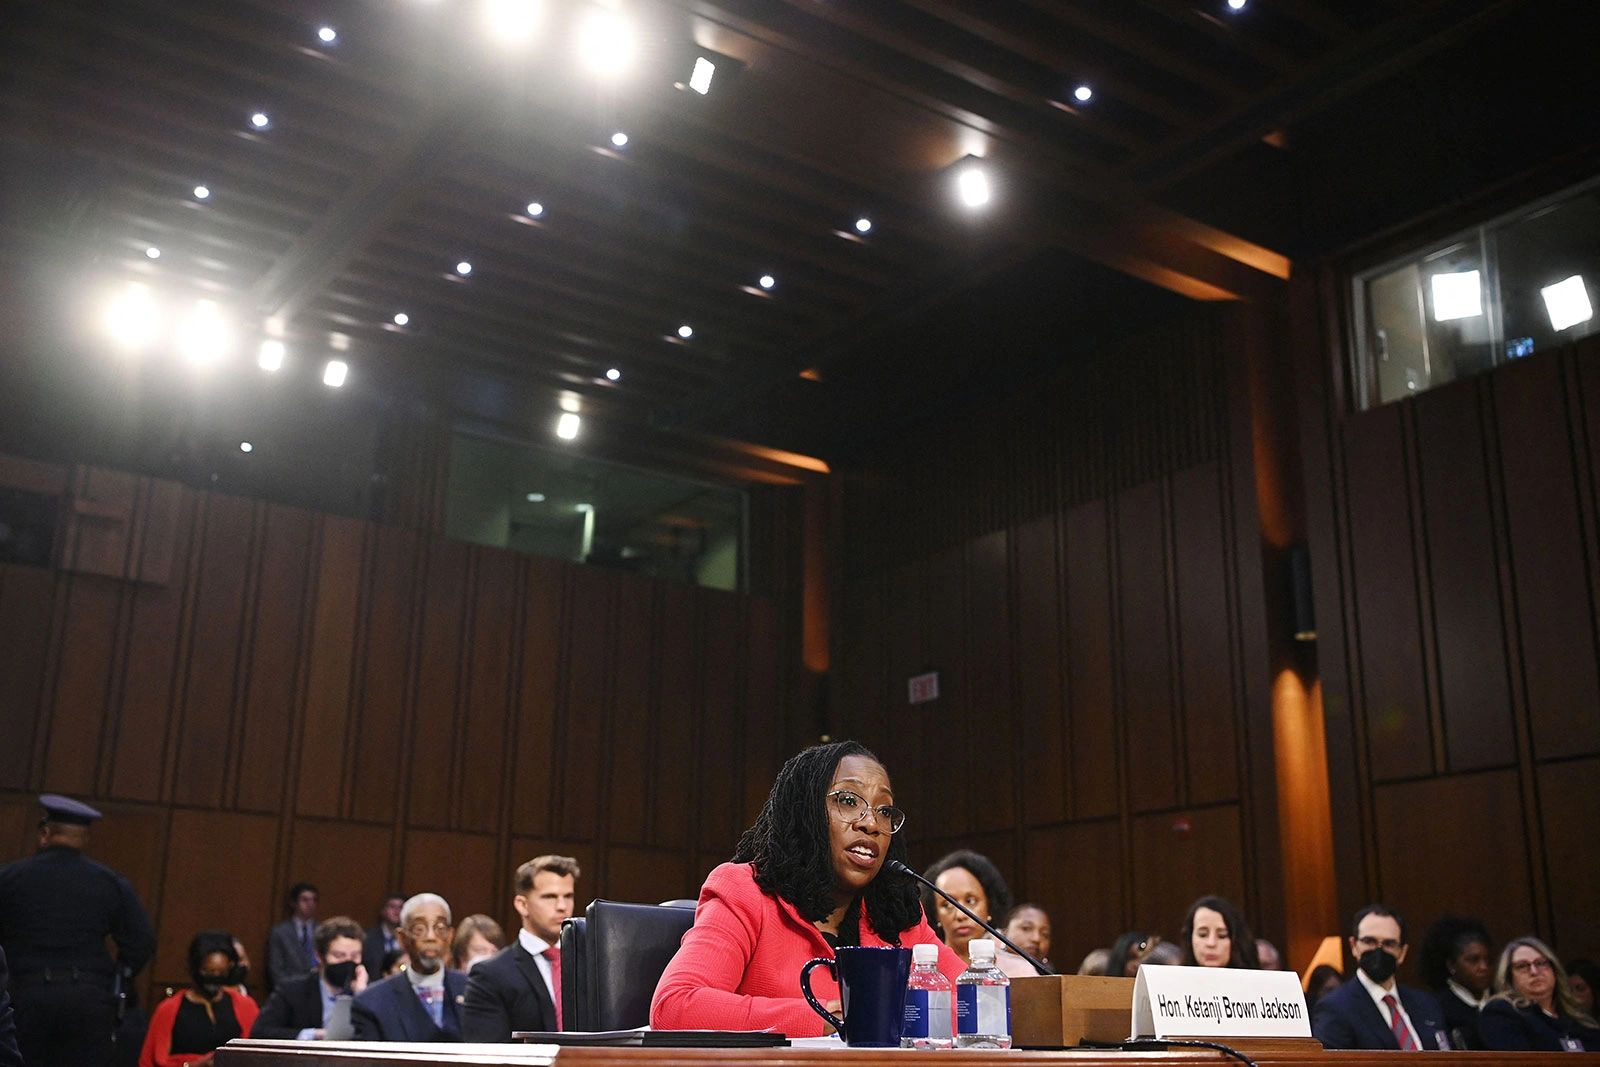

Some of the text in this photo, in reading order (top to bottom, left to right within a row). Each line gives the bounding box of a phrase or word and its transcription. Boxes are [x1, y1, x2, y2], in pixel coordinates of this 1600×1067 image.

[1158, 994, 1301, 1024] Hon. Ketanji Brown Jackson
